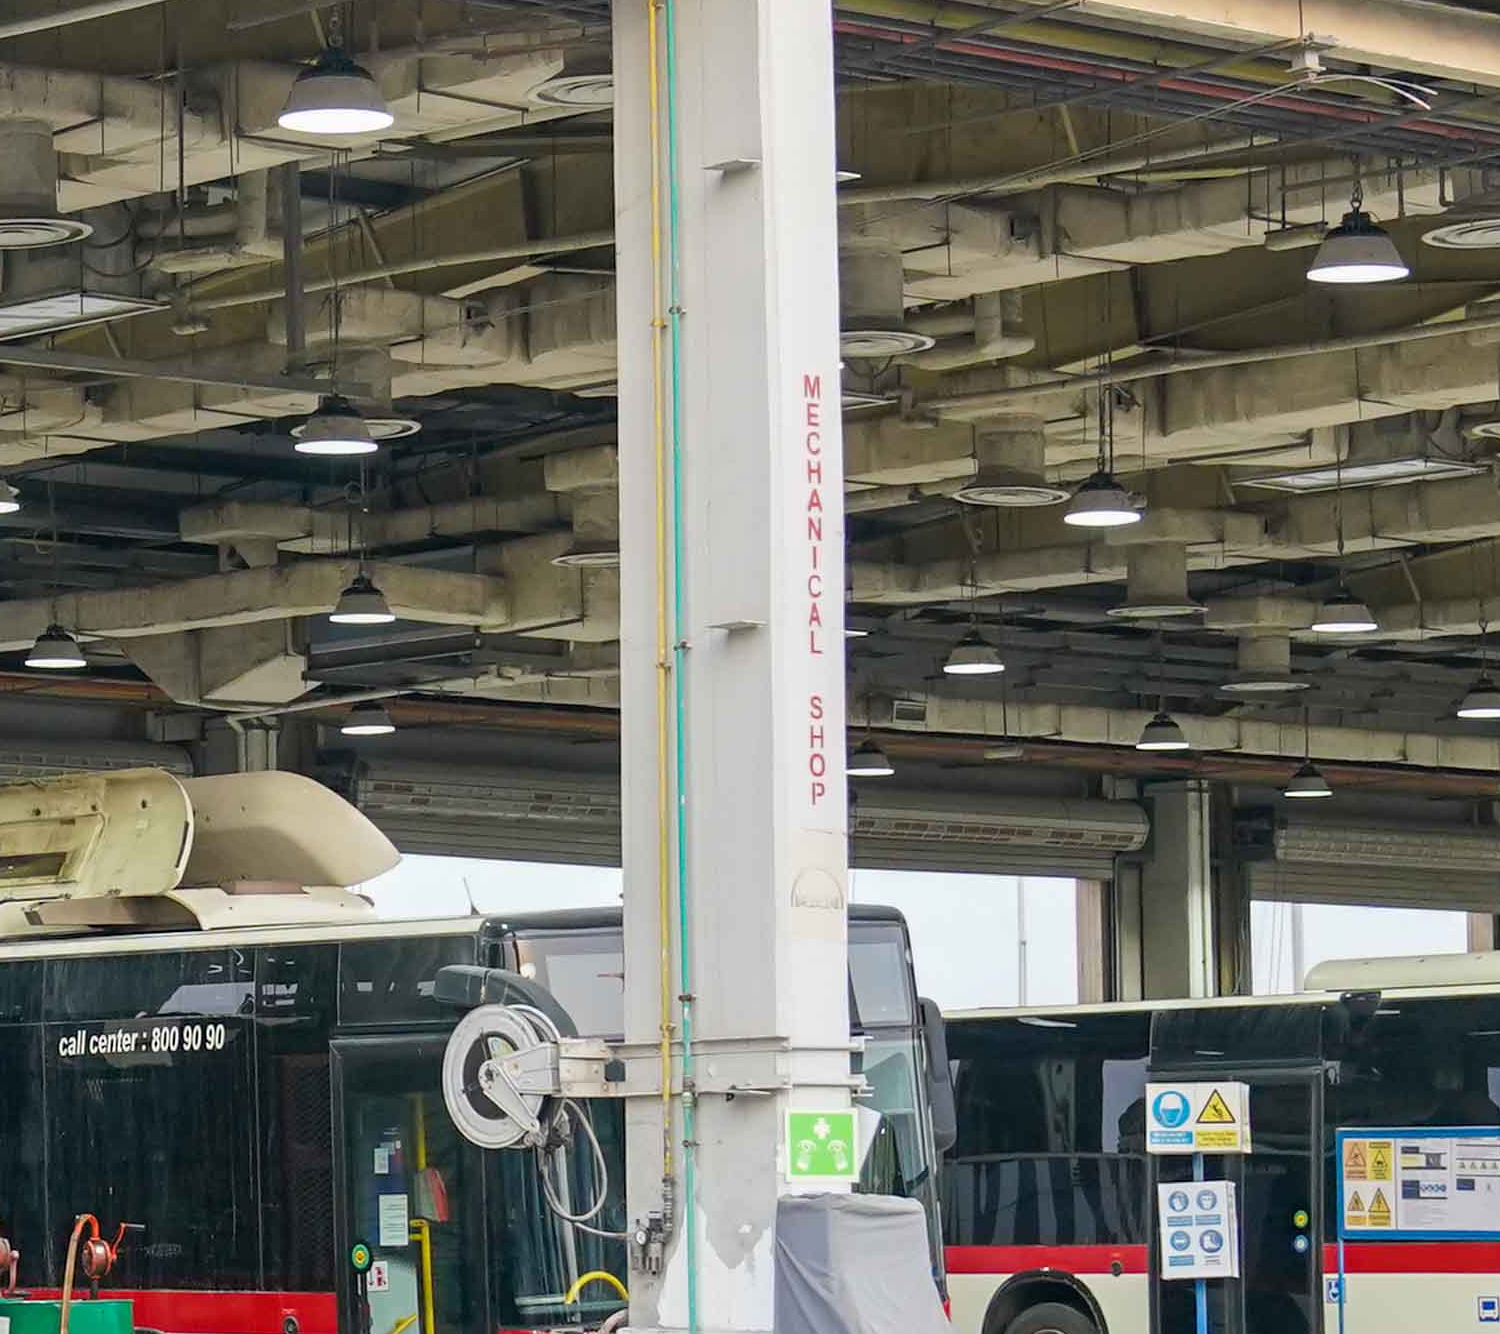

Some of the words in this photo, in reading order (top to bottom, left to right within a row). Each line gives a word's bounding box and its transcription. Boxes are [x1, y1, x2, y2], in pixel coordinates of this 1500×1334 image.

[803, 374, 824, 655] MECHANICAL
[810, 696, 826, 806] SHOP
[59, 1029, 87, 1057] call
[89, 1028, 139, 1055] center
[151, 1025, 180, 1052] 800
[183, 1024, 202, 1051] 90
[205, 1023, 226, 1051] 90
